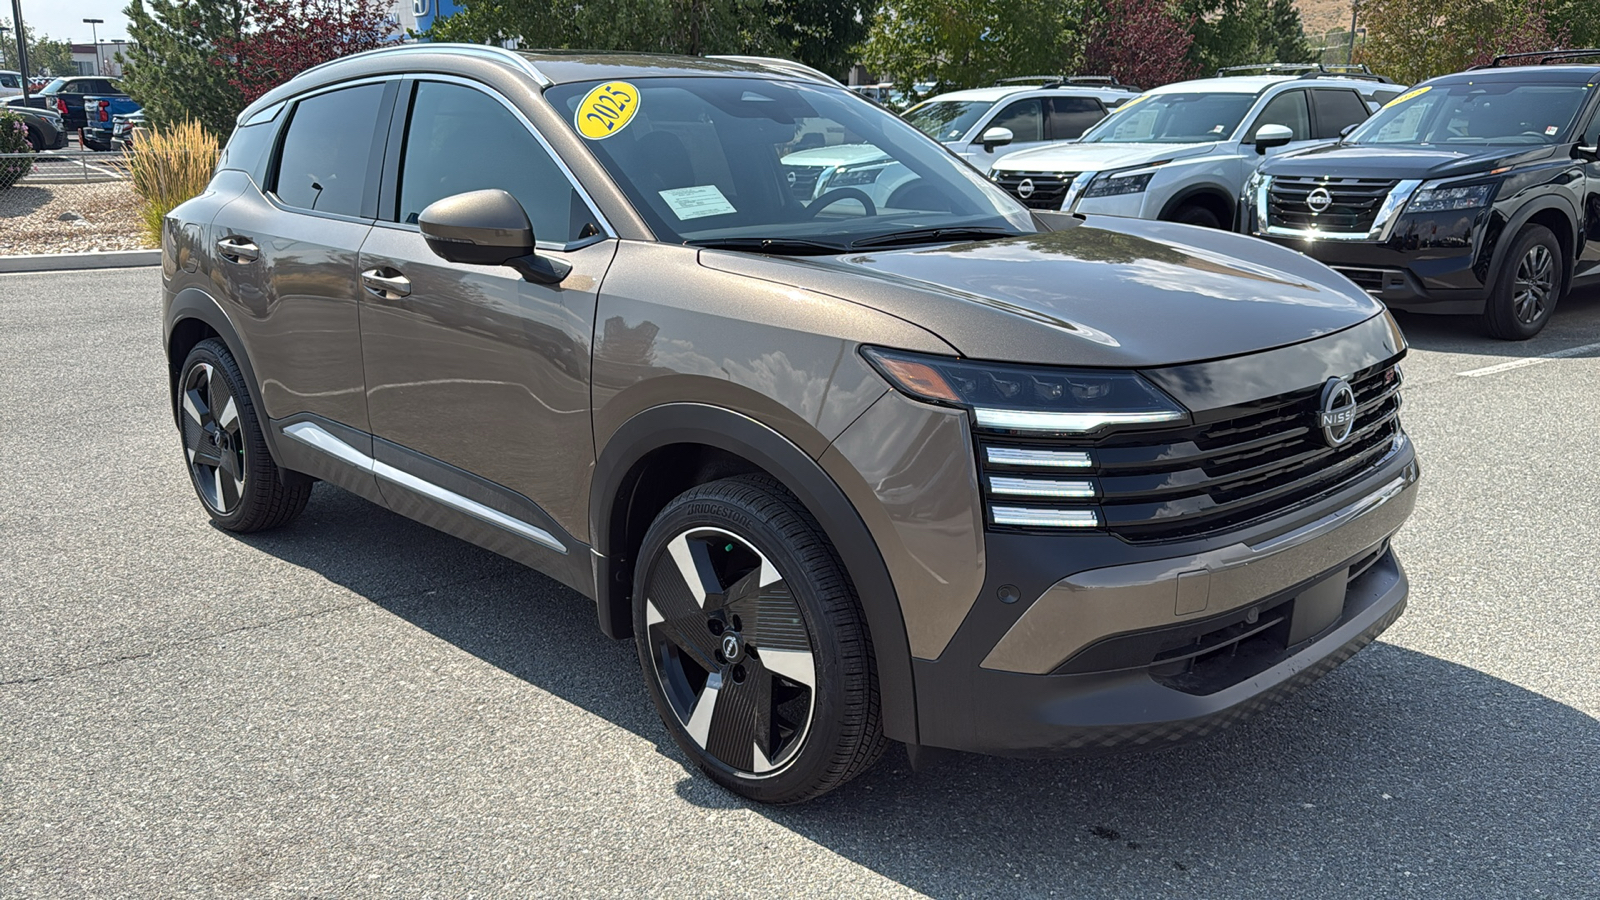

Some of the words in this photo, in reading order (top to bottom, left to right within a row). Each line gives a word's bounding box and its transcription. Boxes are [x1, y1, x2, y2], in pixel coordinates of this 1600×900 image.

[586, 86, 631, 131] 2025
[1322, 409, 1355, 425] NISS
[687, 503, 753, 529] BRIDGESTONE
